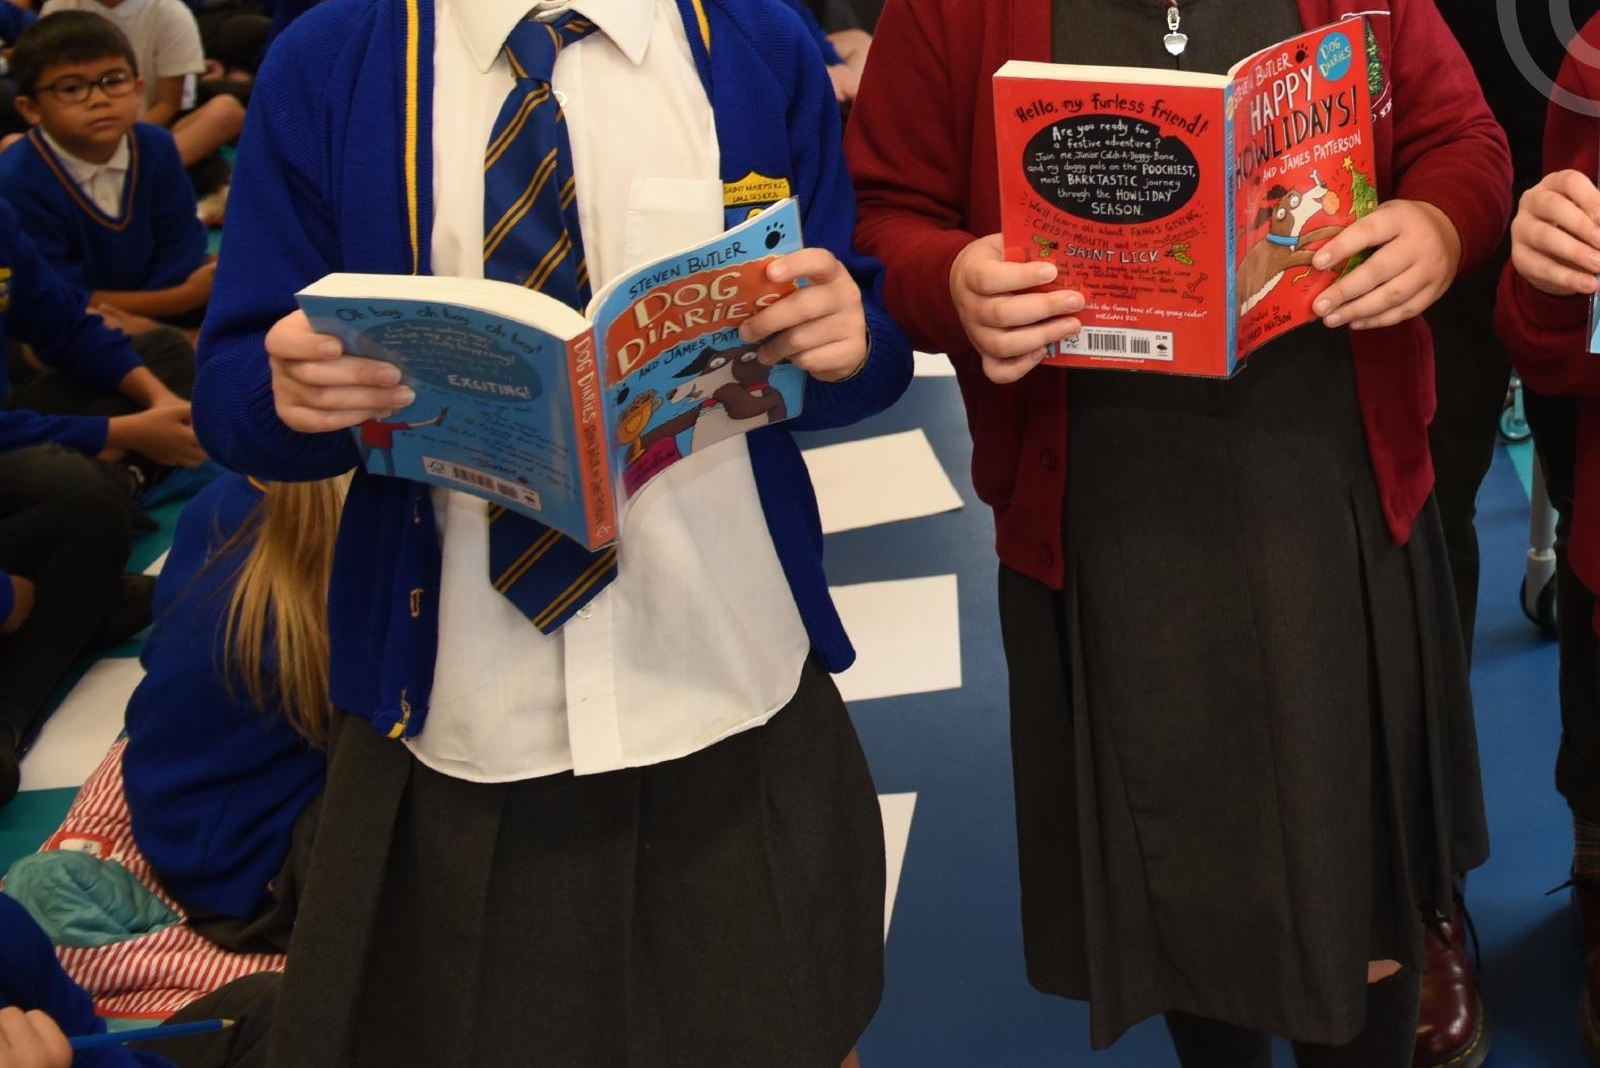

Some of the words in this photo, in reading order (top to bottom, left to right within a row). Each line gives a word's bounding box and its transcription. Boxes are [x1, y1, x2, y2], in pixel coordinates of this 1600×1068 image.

[1320, 38, 1341, 59] DOG
[1254, 52, 1295, 85] BUTLER
[1250, 65, 1313, 136] HAPPY
[1015, 100, 1058, 123] Hello,
[1064, 99, 1084, 113] my
[1091, 93, 1144, 114] furless
[1151, 99, 1209, 137] friend!
[1052, 126, 1072, 140] Are
[1077, 124, 1095, 138] you
[1100, 119, 1128, 135] ready
[1136, 124, 1150, 135] for
[1235, 85, 1357, 190] HOWLIDAYS!
[1035, 152, 1055, 161] Join
[1067, 140, 1101, 149] festive
[1262, 167, 1276, 182] AND
[1280, 151, 1310, 175] JAMES
[1313, 129, 1361, 163] PATTERSON
[1047, 165, 1058, 174] my
[1064, 164, 1086, 173] doggy
[1090, 163, 1106, 172] pals
[1123, 163, 1138, 171] the
[1142, 164, 1196, 177] POOCHIEST,
[1058, 189, 1090, 202] through
[1096, 191, 1111, 199] the
[1117, 190, 1172, 202] HOWLIDAY
[1068, 174, 1138, 186] BARKTASTIC
[1143, 178, 1180, 193] journey
[1091, 202, 1144, 216] SEASON.
[1066, 244, 1114, 263] SAINT
[1120, 251, 1160, 263] LICK
[628, 264, 681, 299] STEVEN
[687, 242, 747, 274] BUTLER
[634, 271, 741, 329] DOG
[574, 336, 592, 372] DOG
[639, 360, 661, 380] AND
[664, 336, 706, 364] JAMES
[448, 375, 532, 400] EXCITING!
